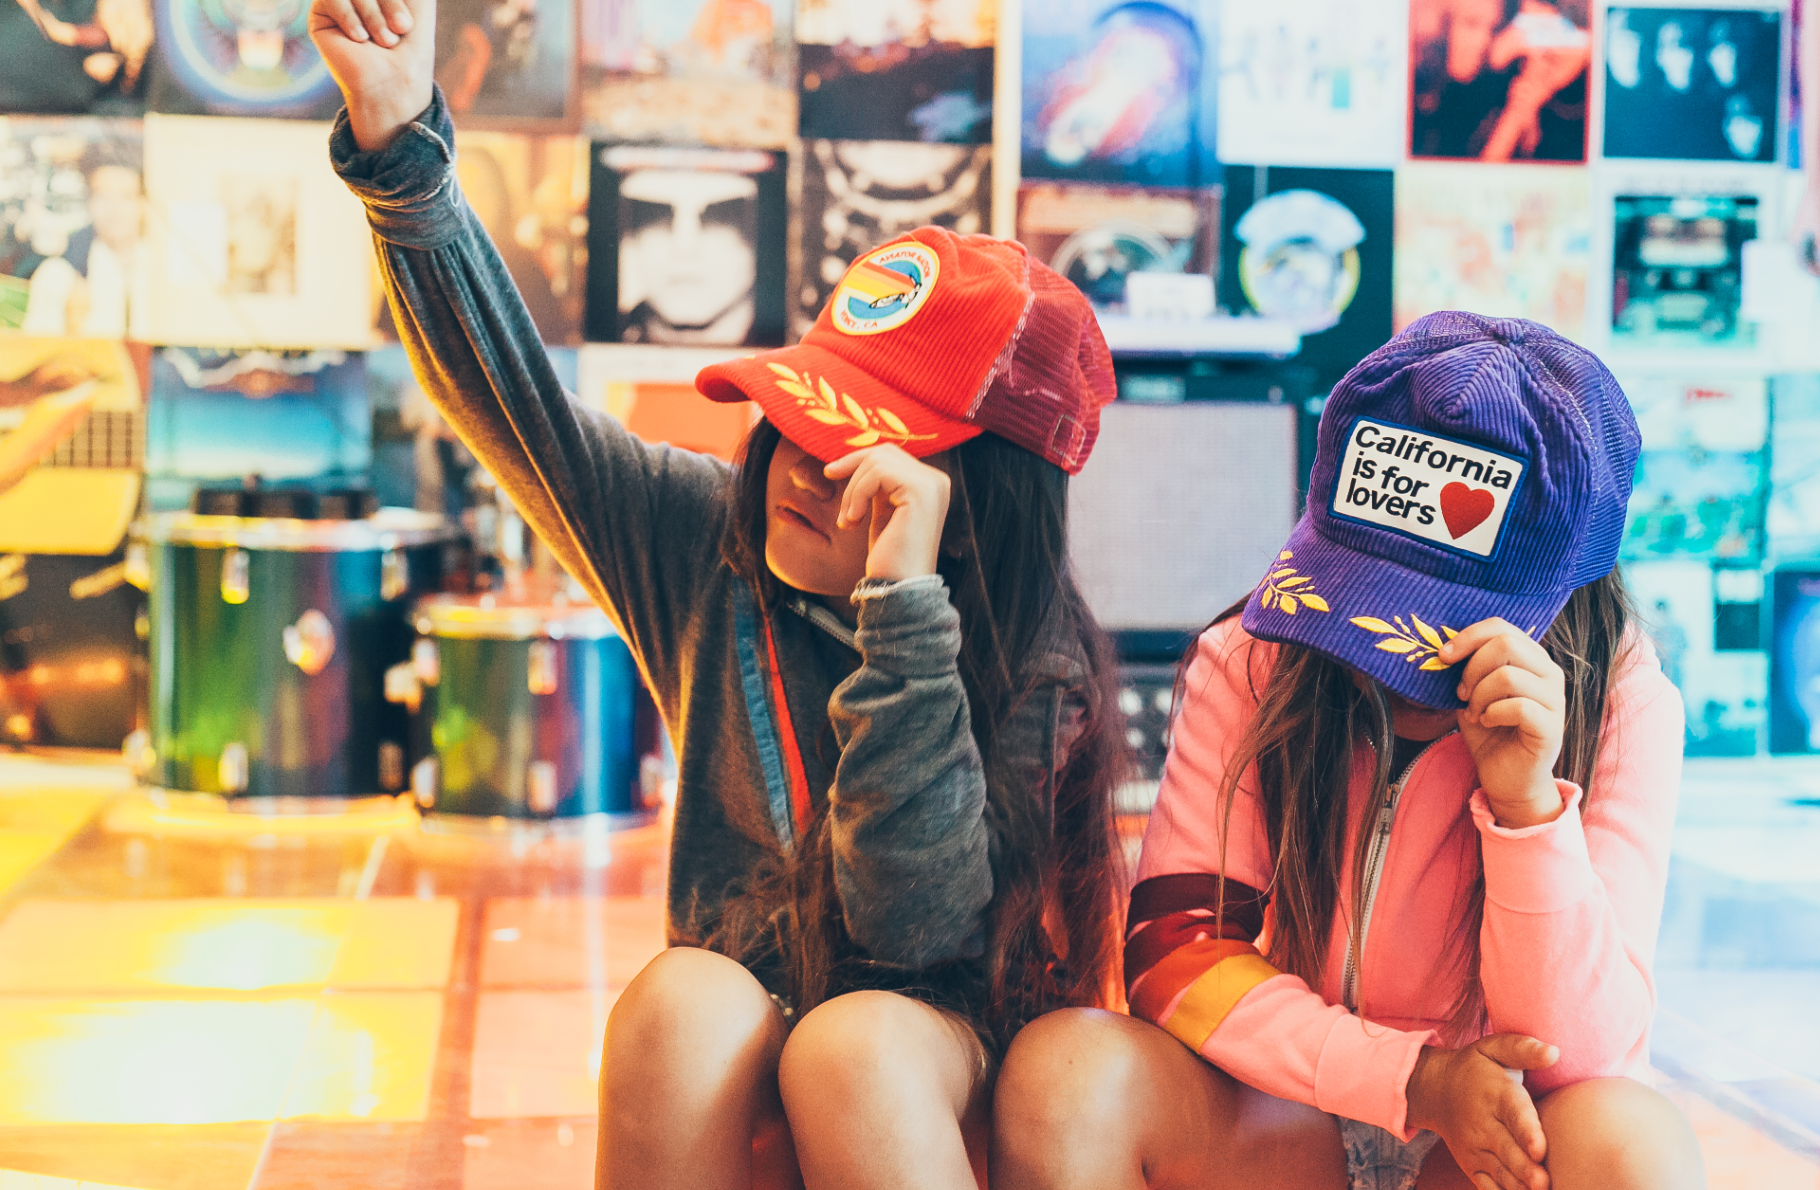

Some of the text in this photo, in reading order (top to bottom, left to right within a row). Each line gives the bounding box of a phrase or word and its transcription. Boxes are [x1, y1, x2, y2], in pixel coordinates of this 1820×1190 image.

[879, 251, 916, 263] AVIATOR
[863, 320, 878, 328] CA
[1352, 450, 1430, 498] is for
[1355, 425, 1513, 490] California
[1345, 477, 1437, 525] lovers
